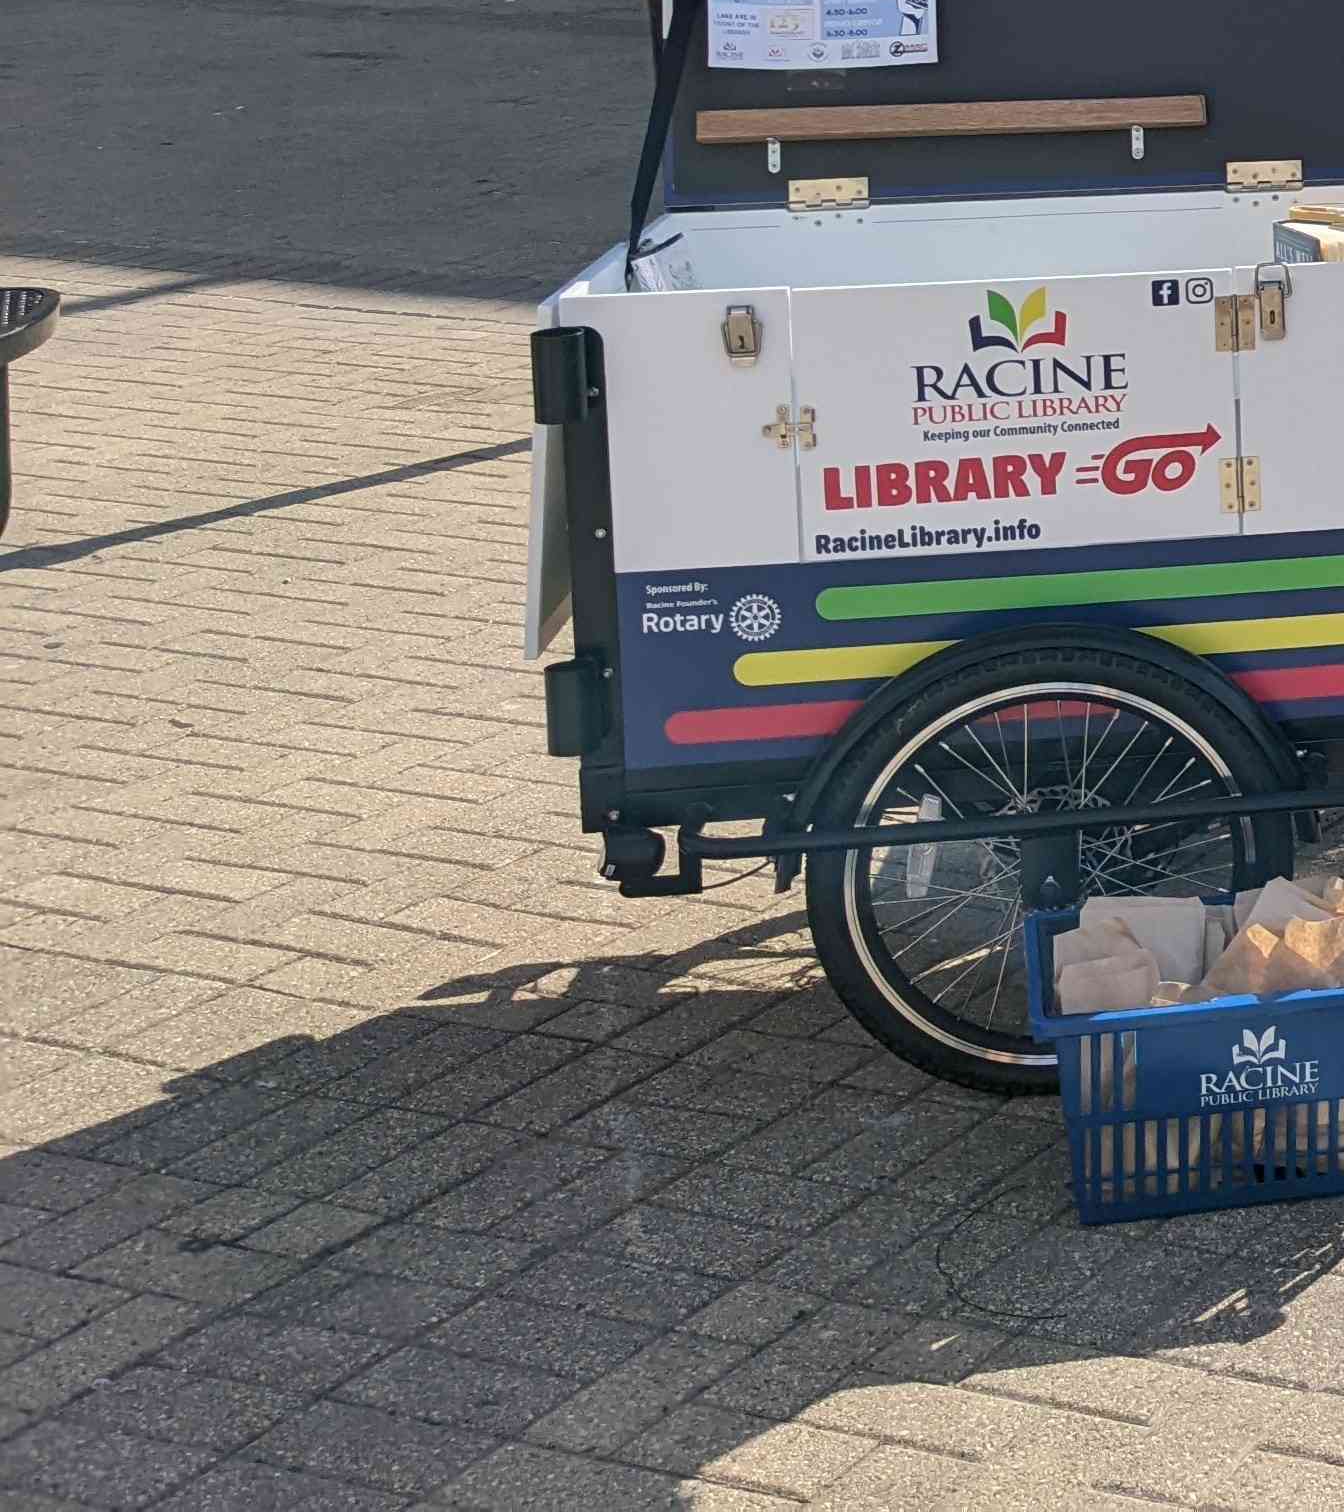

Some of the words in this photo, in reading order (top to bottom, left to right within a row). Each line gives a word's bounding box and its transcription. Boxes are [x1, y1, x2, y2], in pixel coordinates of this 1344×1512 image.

[911, 353, 1128, 402] RACINE
[912, 400, 1010, 426] PUBLIC
[1016, 393, 1127, 420] LIBRARY
[923, 428, 970, 443] Keeping
[971, 426, 991, 439] our
[993, 422, 1059, 438] Community
[1060, 417, 1120, 434] Connected
[823, 451, 1067, 511] LIBRARY
[815, 519, 1041, 554] RacineLibrary.info
[645, 582, 692, 596] Sponsored
[694, 582, 709, 593] By:
[642, 612, 724, 634] Rotary
[1200, 1060, 1320, 1095] RACINE
[1200, 1090, 1254, 1107] PUBLIC
[1258, 1081, 1320, 1100] LIBRARY
